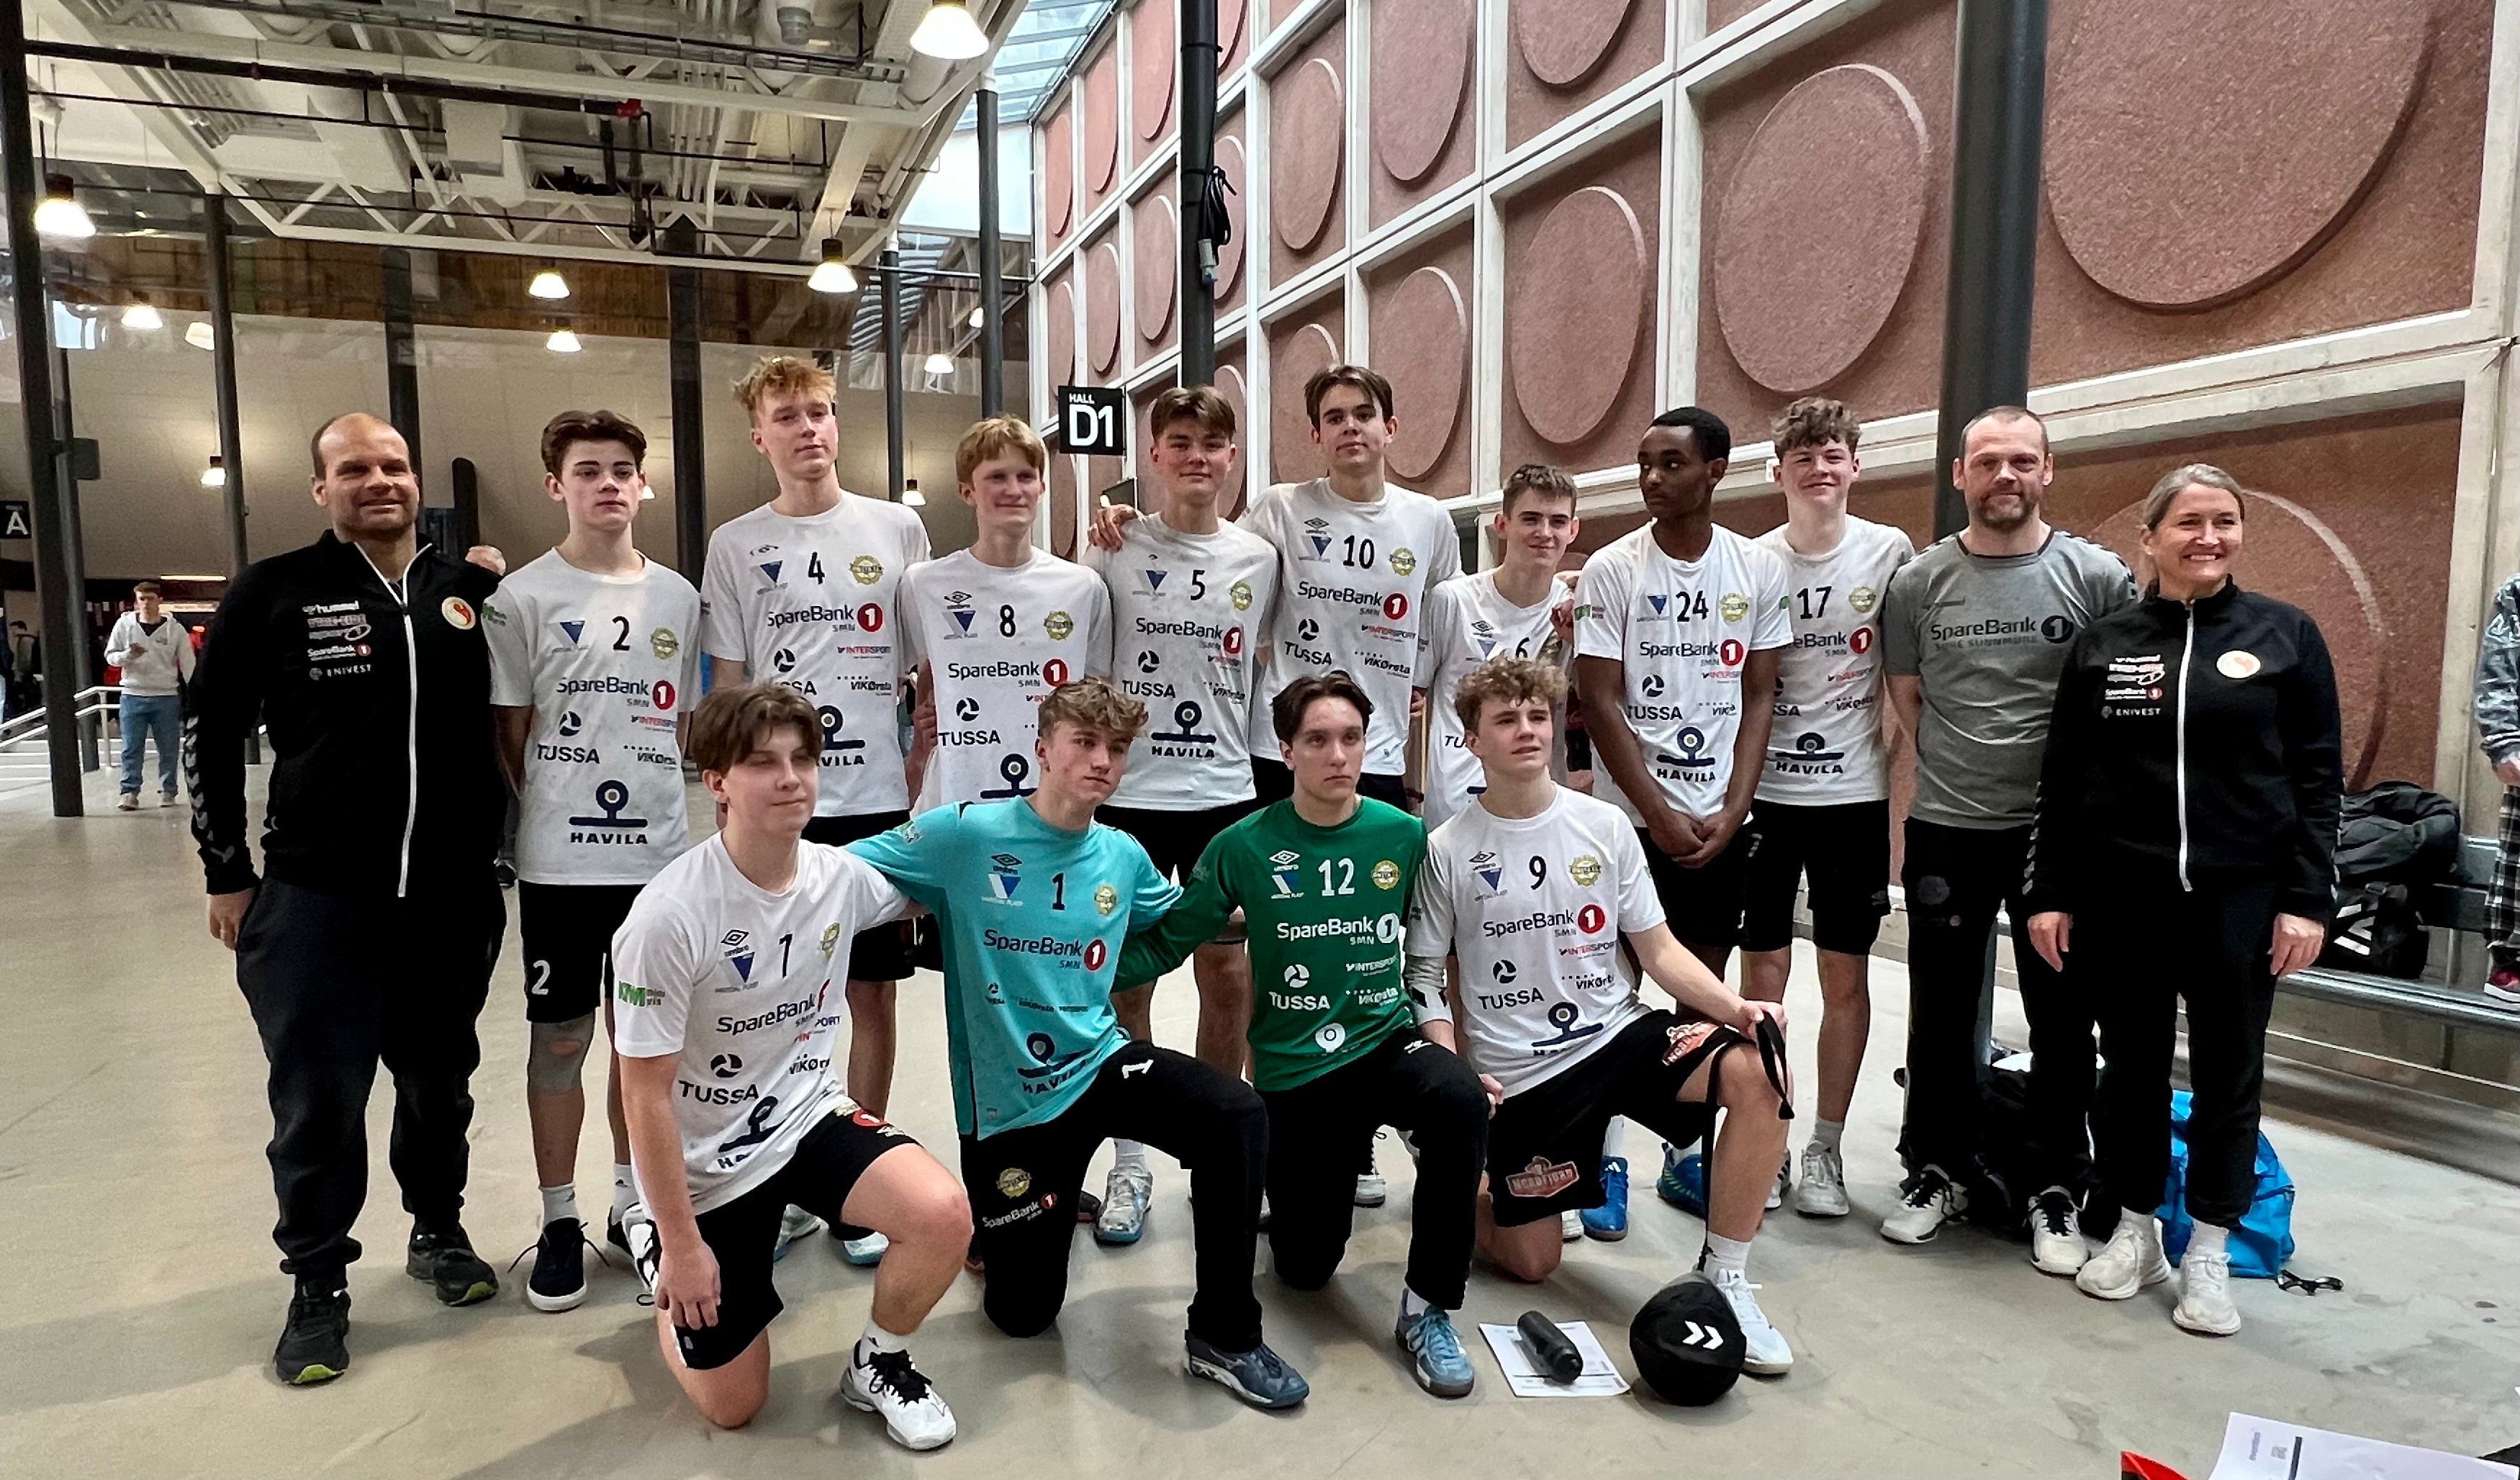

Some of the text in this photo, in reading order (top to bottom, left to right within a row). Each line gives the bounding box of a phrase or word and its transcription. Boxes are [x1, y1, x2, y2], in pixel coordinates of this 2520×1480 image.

[1069, 393, 1094, 404] HALL
[1069, 404, 1114, 447] D1
[6, 511, 28, 534] A
[1342, 535, 1375, 569] 10
[808, 551, 825, 585] 4
[1189, 569, 1206, 600] 5
[1298, 580, 1383, 607] SpareBank
[1675, 590, 1710, 623] 24
[1797, 586, 1833, 620] 17
[767, 605, 854, 628] SpareBank
[999, 604, 1016, 638] 8
[1136, 617, 1223, 640] SpareBank
[612, 615, 631, 651] 2
[1794, 631, 1847, 649] eBank
[1930, 617, 2036, 641] SpareBank
[1284, 641, 1332, 666] TUSSA
[1639, 641, 1719, 658] SpareBank
[947, 661, 1040, 680] SpareBank
[556, 677, 649, 695] SpareBank
[1121, 680, 1176, 699] TUSSA
[938, 729, 1001, 746] TUSSA
[538, 744, 600, 764] TUSSA
[818, 755, 865, 767] VILA
[1151, 746, 1215, 759] HAVILA
[1656, 768, 1716, 782] HAVILA
[1775, 761, 1844, 775] HAVILA
[570, 833, 648, 844] HAVILA
[1318, 857, 1355, 897] 12
[1529, 855, 1546, 890] 9
[1052, 872, 1065, 911] 1
[1277, 916, 1374, 942] SpareBank
[1483, 909, 1574, 938] SpareBank
[983, 929, 1083, 957] SpareBank
[1350, 936, 1374, 945] SMN
[531, 960, 550, 995] 2
[1268, 991, 1331, 1011] TUSSA
[1478, 988, 1545, 1010] TUSSA
[716, 993, 817, 1036] SpareBank
[790, 1058, 830, 1074] VIKØr
[678, 1080, 759, 1105] TUSSA
[982, 1201, 1039, 1229] SpareBank
